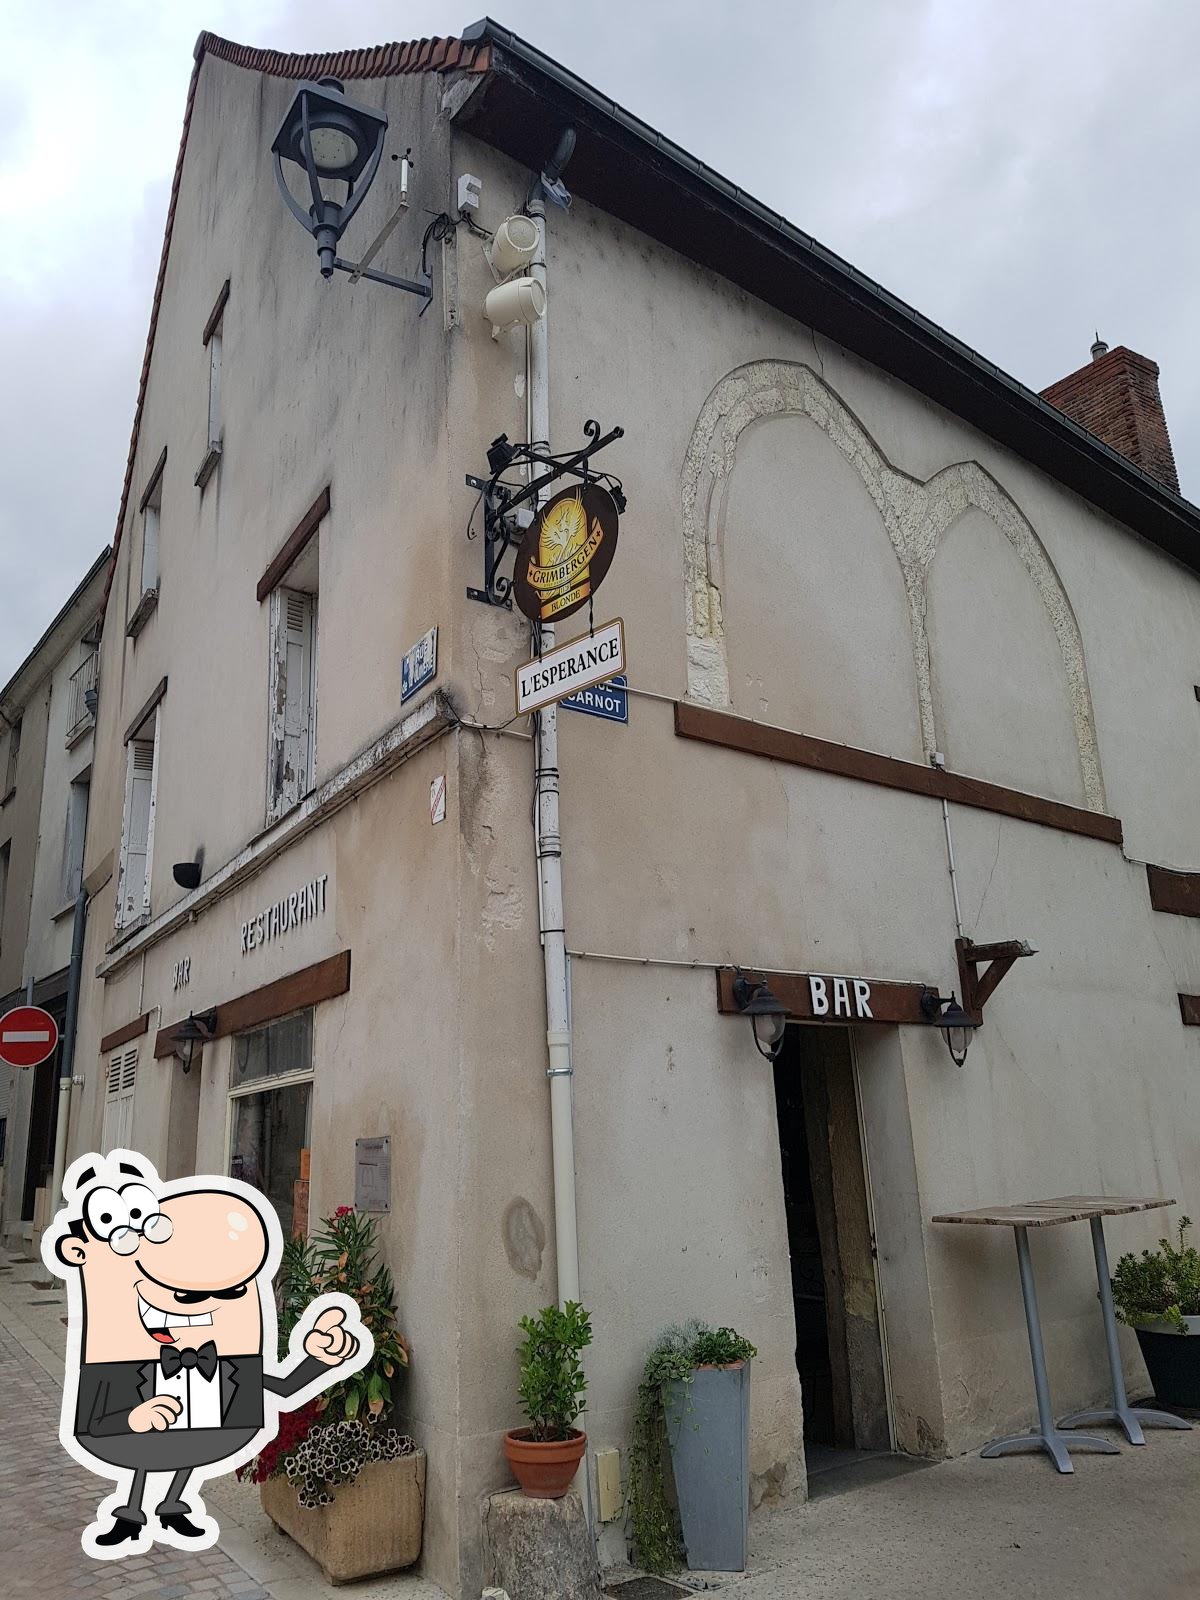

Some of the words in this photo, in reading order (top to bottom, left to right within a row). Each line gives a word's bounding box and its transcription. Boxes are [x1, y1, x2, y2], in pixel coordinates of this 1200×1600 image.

[533, 538, 597, 583] GRIMBERGEN
[551, 590, 581, 611] BLONDE
[521, 637, 619, 699] L'ESPERANCE
[240, 874, 328, 953] RESTAURANT
[173, 956, 191, 989] BAR
[809, 976, 873, 1018] BAR
